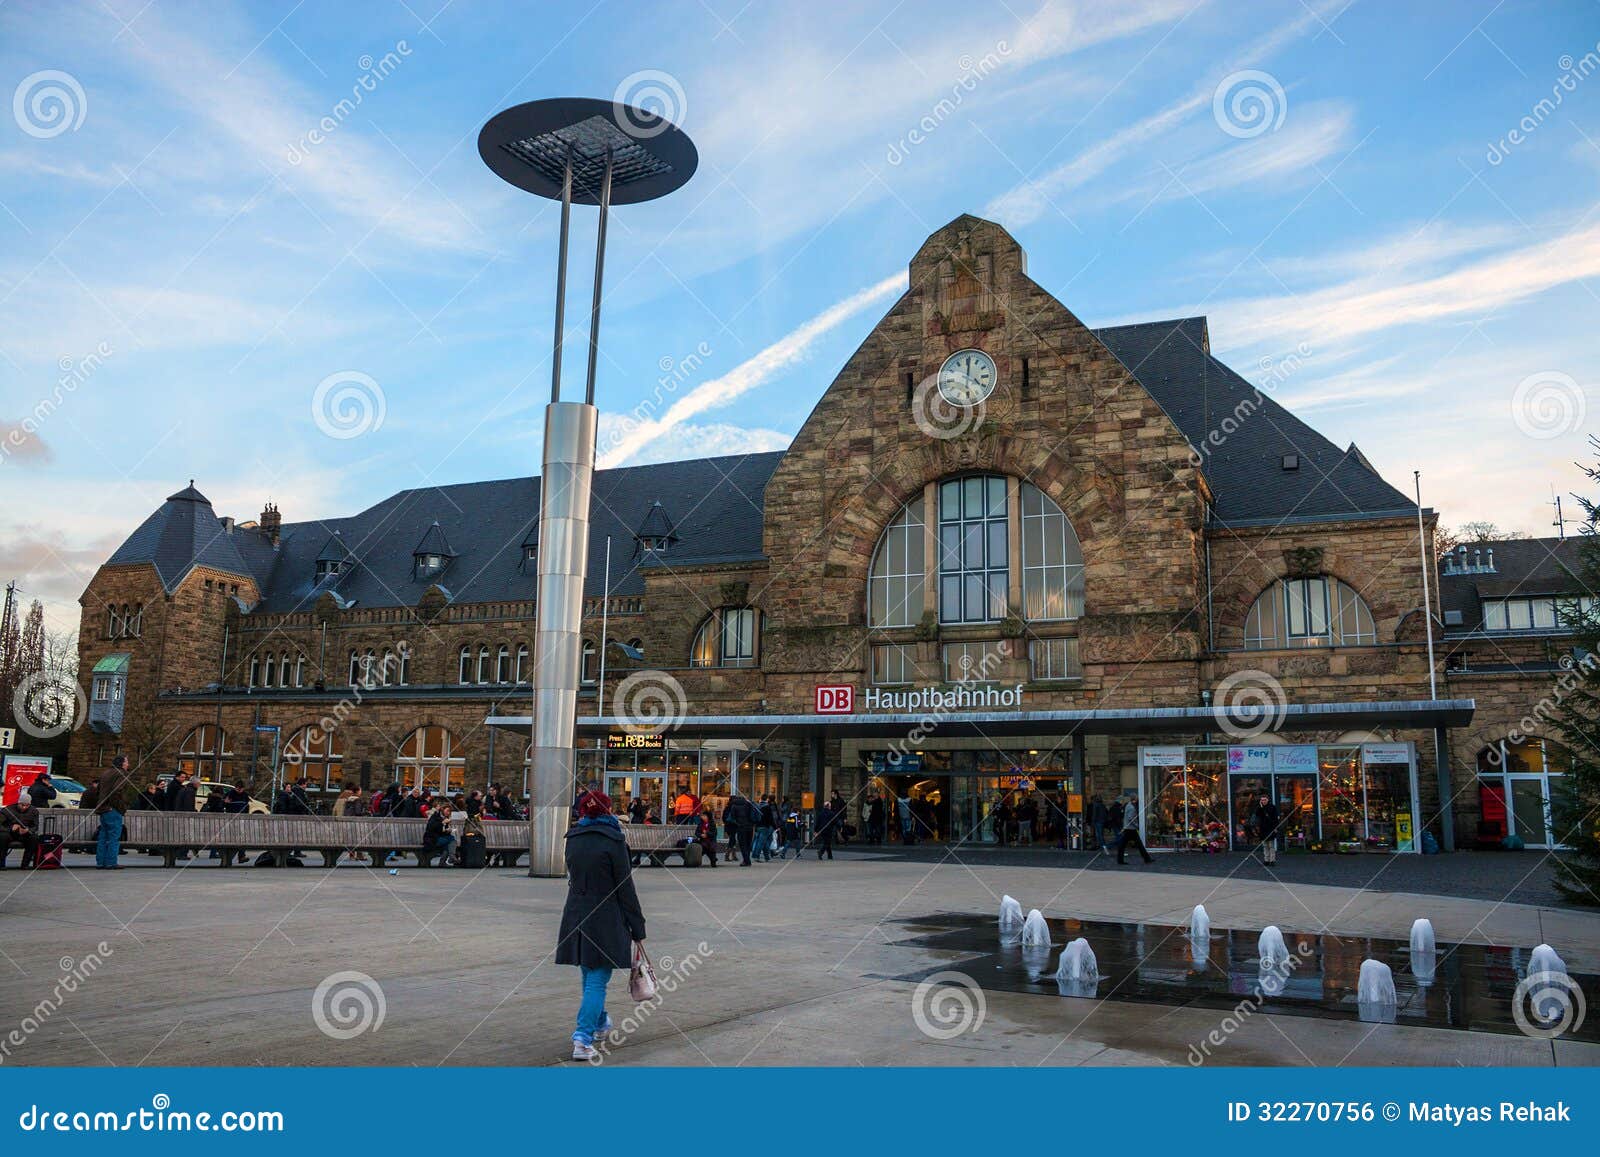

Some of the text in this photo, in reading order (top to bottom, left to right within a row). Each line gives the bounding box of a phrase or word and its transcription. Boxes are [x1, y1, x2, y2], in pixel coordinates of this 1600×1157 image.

[819, 684, 1023, 712] DB Hauptbahnhof
[1248, 750, 1269, 758] Fery
